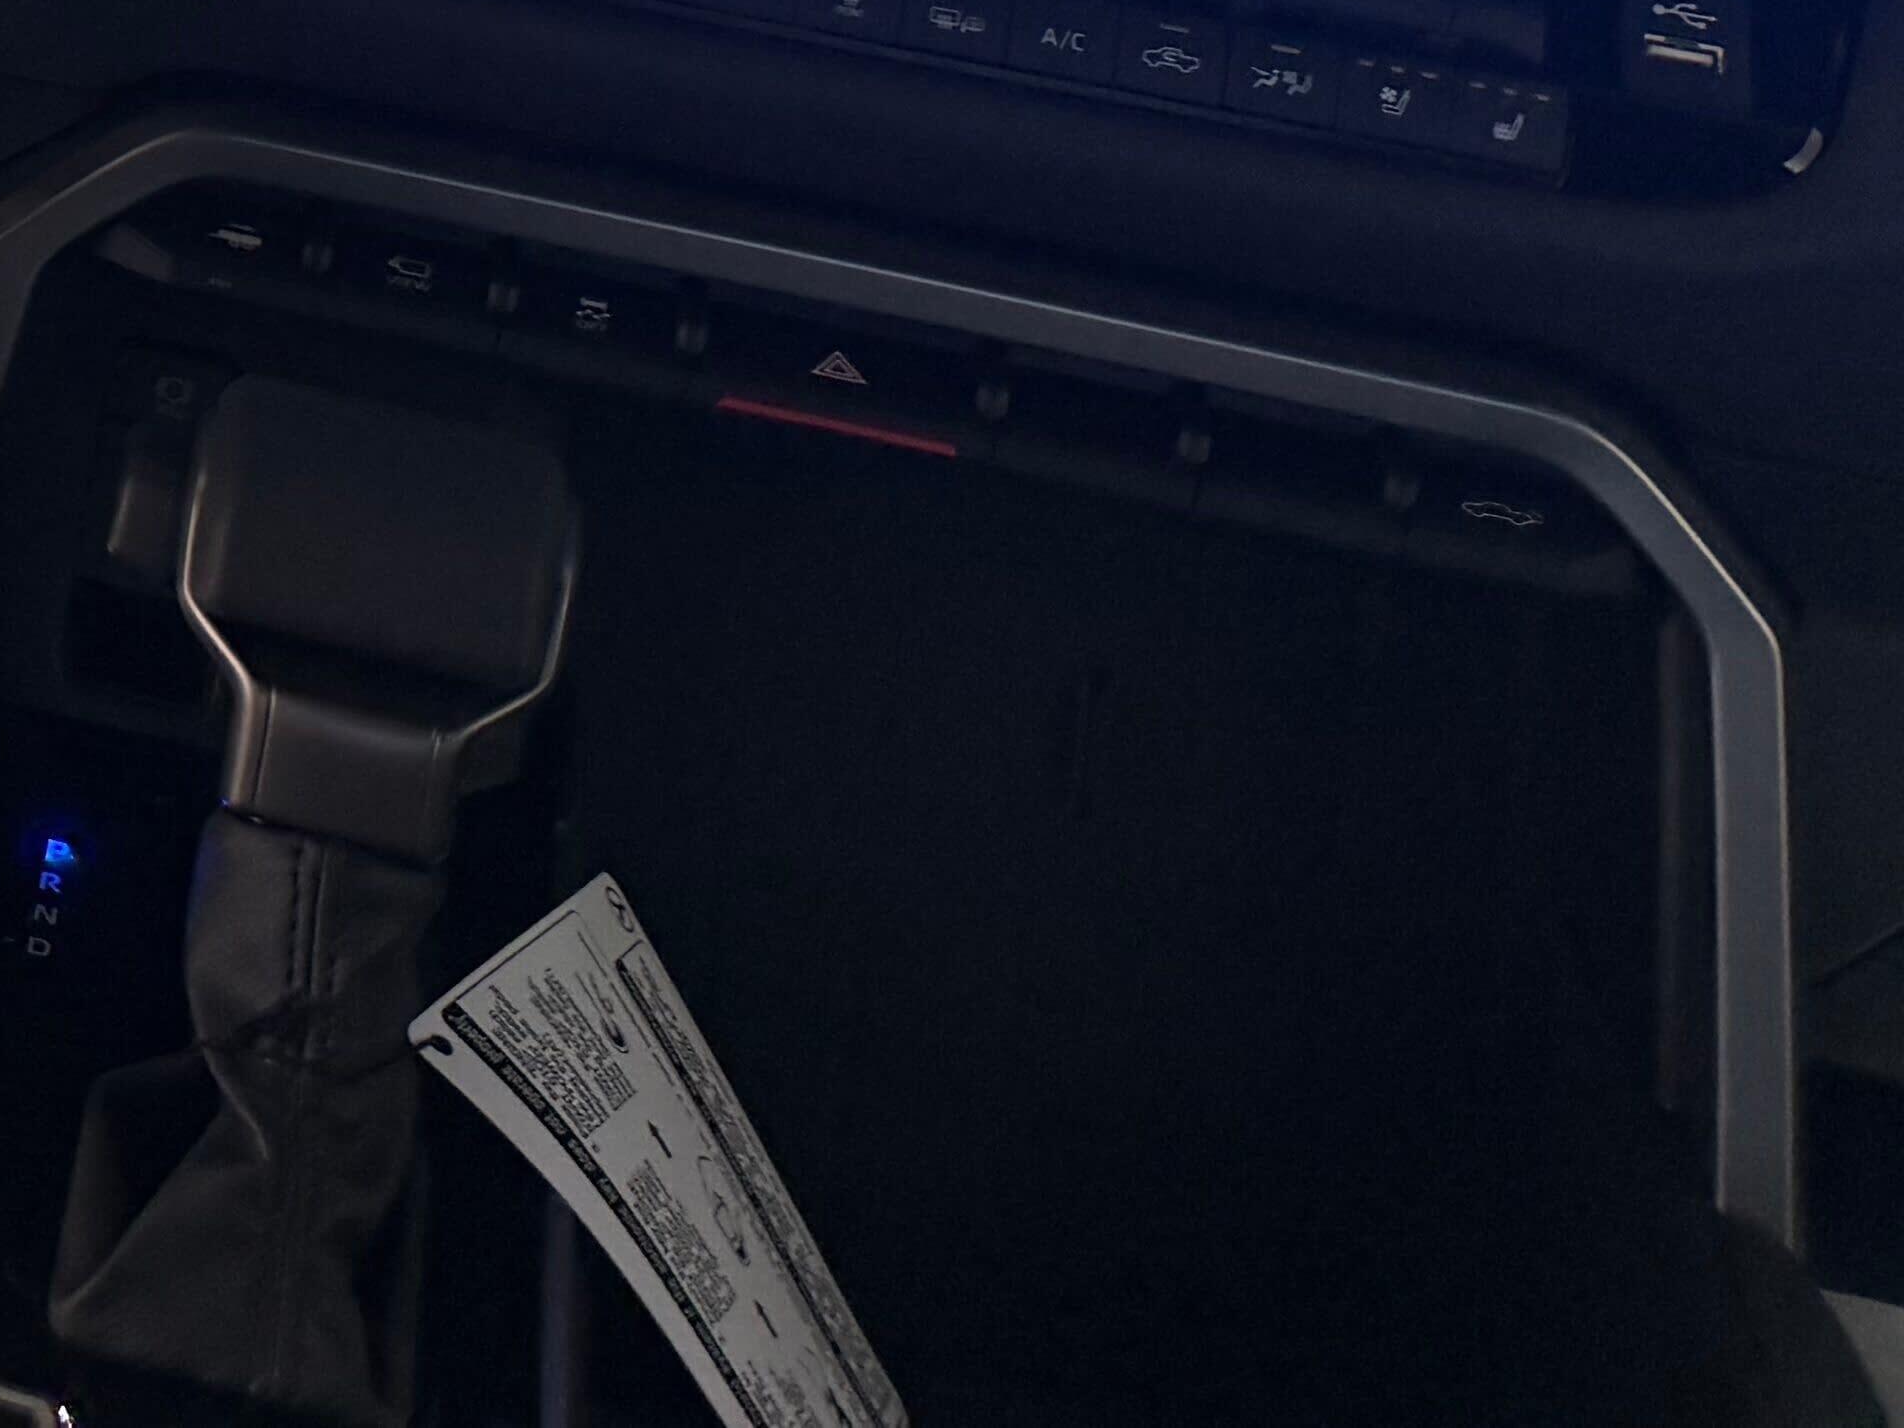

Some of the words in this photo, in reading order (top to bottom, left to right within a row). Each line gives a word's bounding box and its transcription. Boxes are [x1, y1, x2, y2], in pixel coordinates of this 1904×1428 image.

[1040, 25, 1086, 54] A/C
[45, 839, 74, 863] P
[39, 871, 63, 894] R
[34, 903, 59, 926] N
[27, 935, 52, 957] D
